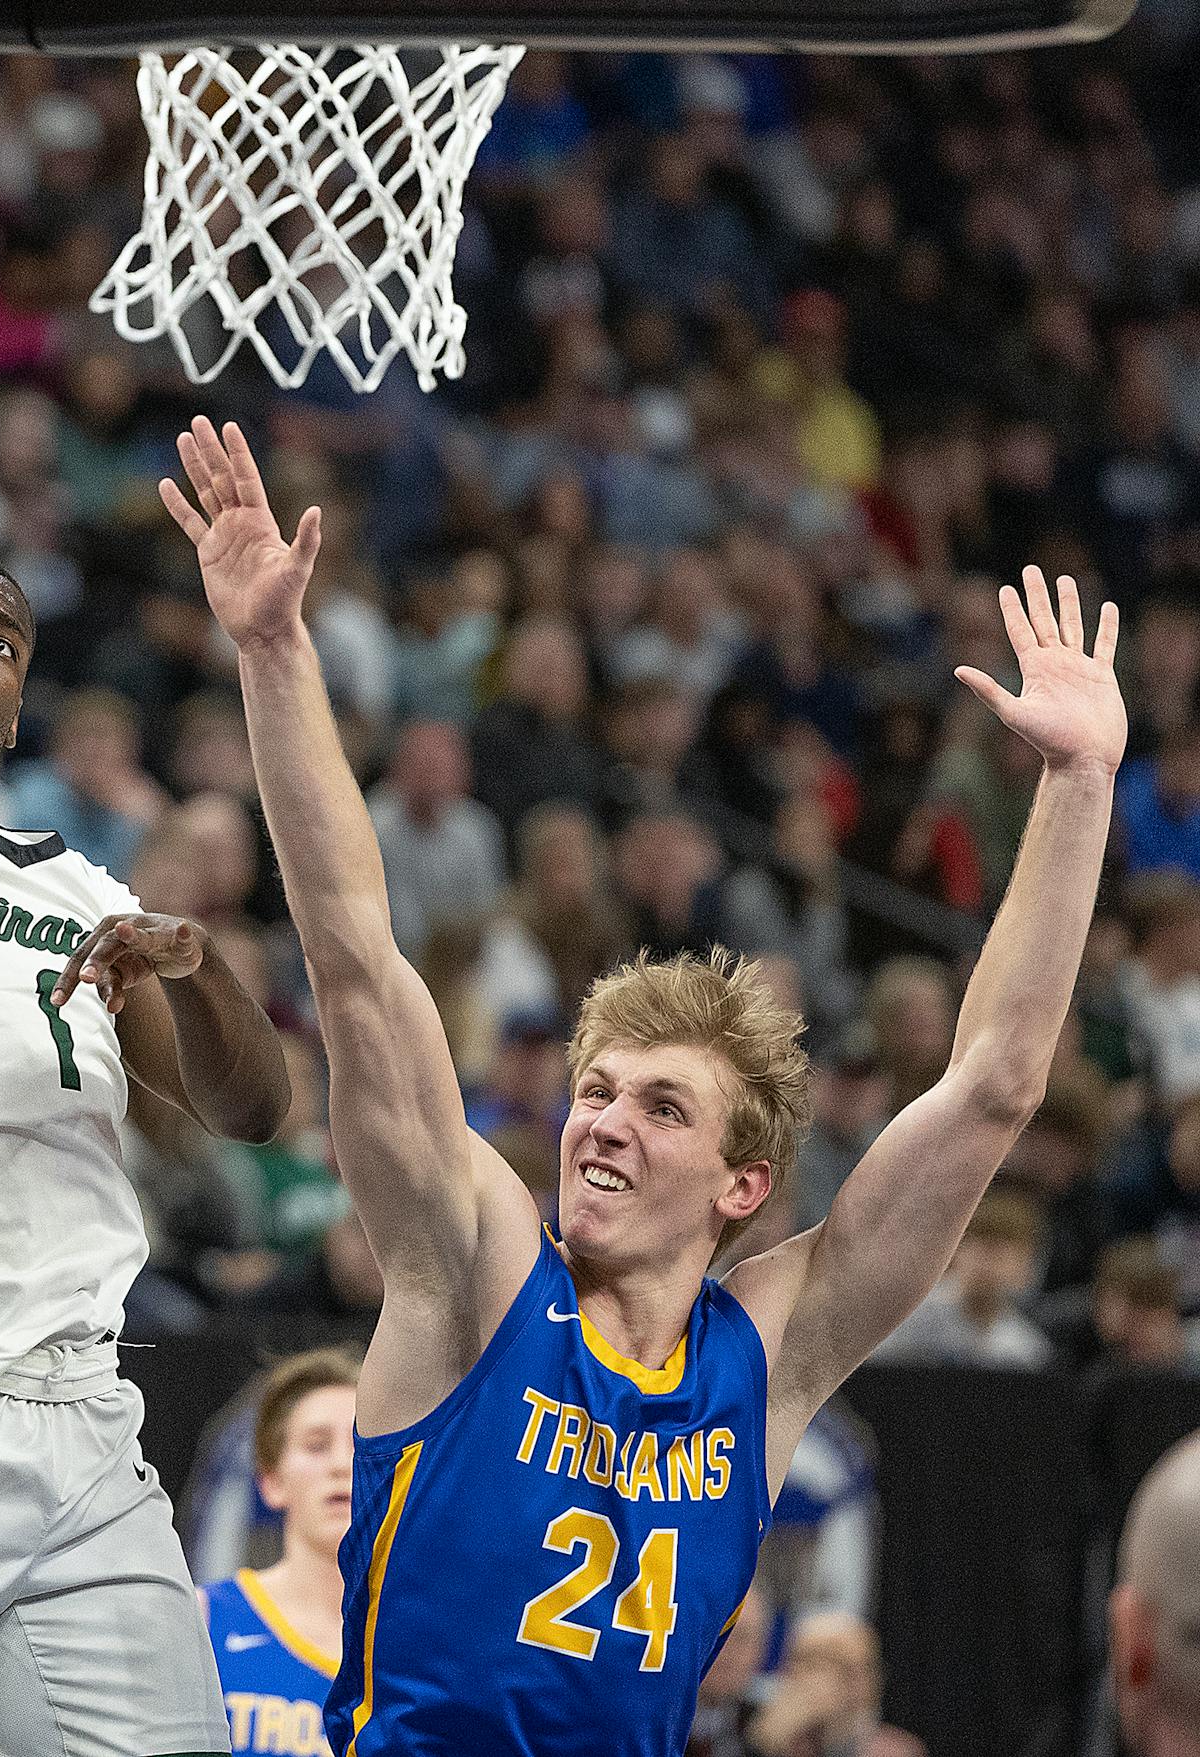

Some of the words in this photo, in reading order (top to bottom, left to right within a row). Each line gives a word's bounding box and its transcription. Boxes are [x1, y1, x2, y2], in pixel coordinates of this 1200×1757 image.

[36, 968, 82, 1091] 1
[515, 1386, 735, 1502] TROJANS
[515, 1506, 678, 1673] 24
[224, 1690, 335, 1757] TRO
